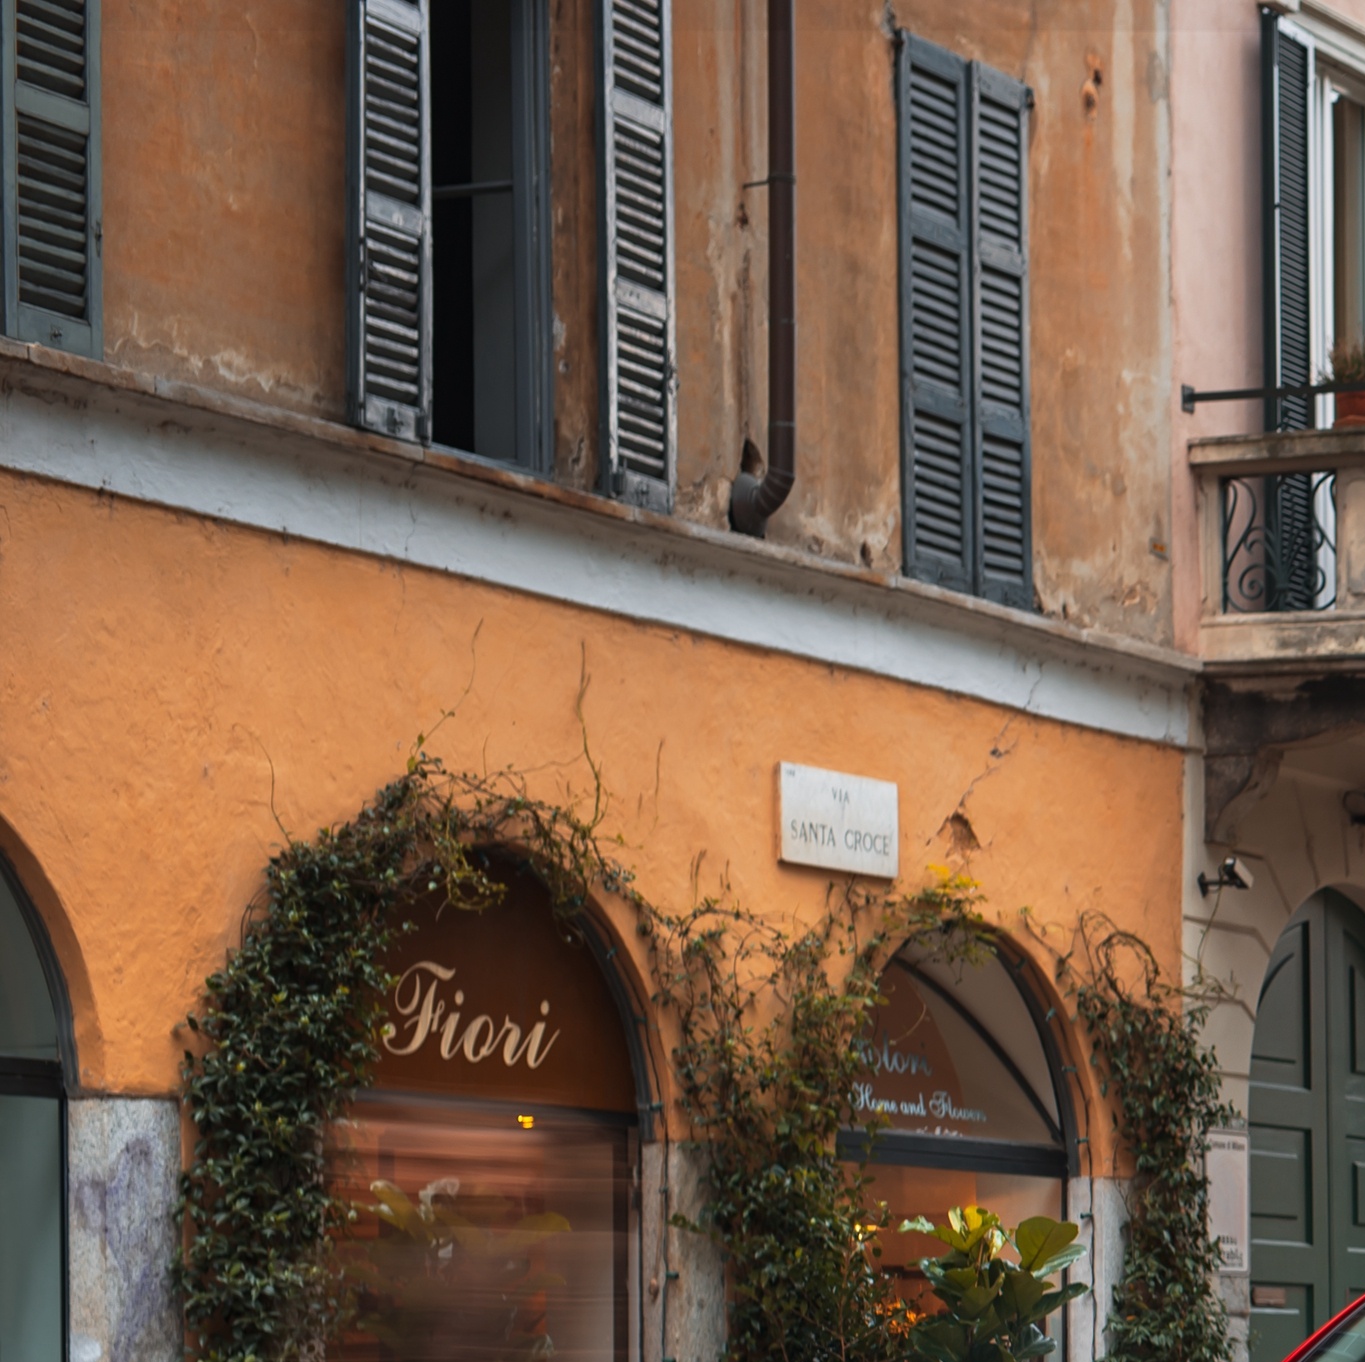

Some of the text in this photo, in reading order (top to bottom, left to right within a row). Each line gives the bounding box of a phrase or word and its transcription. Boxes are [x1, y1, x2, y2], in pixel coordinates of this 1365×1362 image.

[831, 787, 850, 804] VIA
[790, 819, 889, 856] SANTA CROCE
[382, 960, 560, 1069] Fiori
[847, 1081, 898, 1114] Home
[900, 1092, 926, 1117] and
